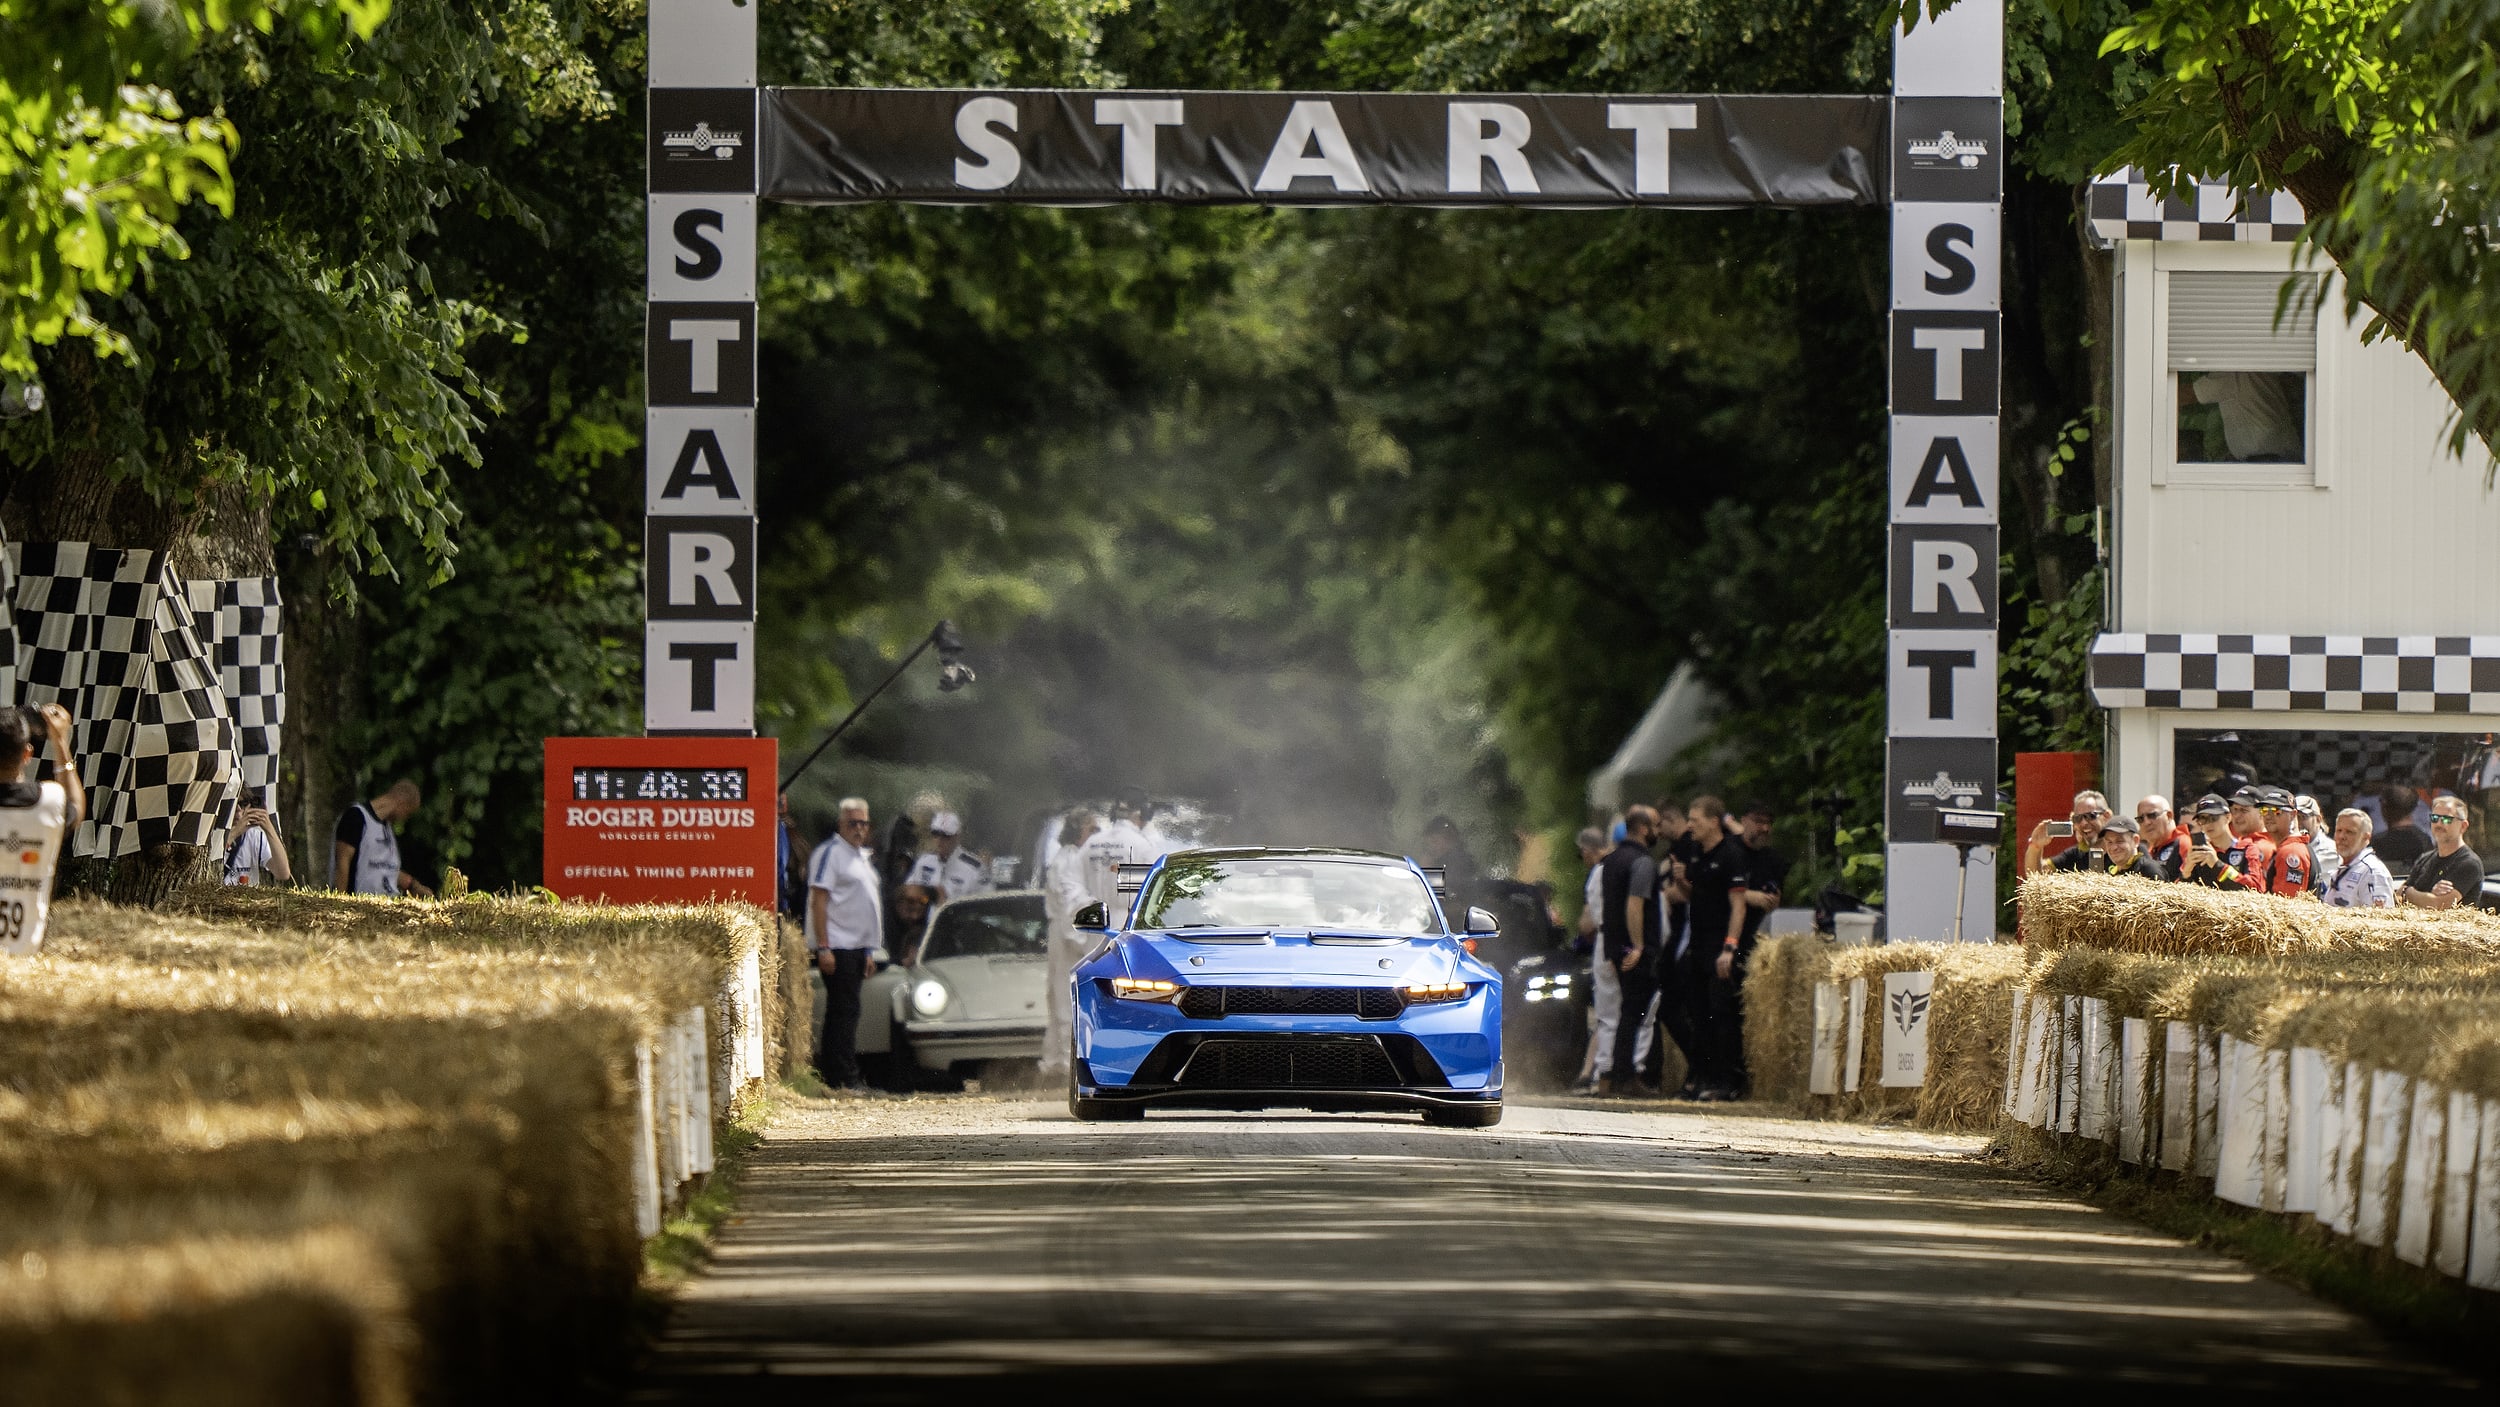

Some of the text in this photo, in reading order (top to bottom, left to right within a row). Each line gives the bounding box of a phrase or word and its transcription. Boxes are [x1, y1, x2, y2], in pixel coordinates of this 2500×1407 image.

[955, 96, 1698, 196] START
[661, 208, 742, 712] START
[1905, 222, 1986, 720] START
[566, 806, 755, 828] ROGER DUBUIS
[564, 866, 755, 879] OFFICIAL TIMING PARTNER
